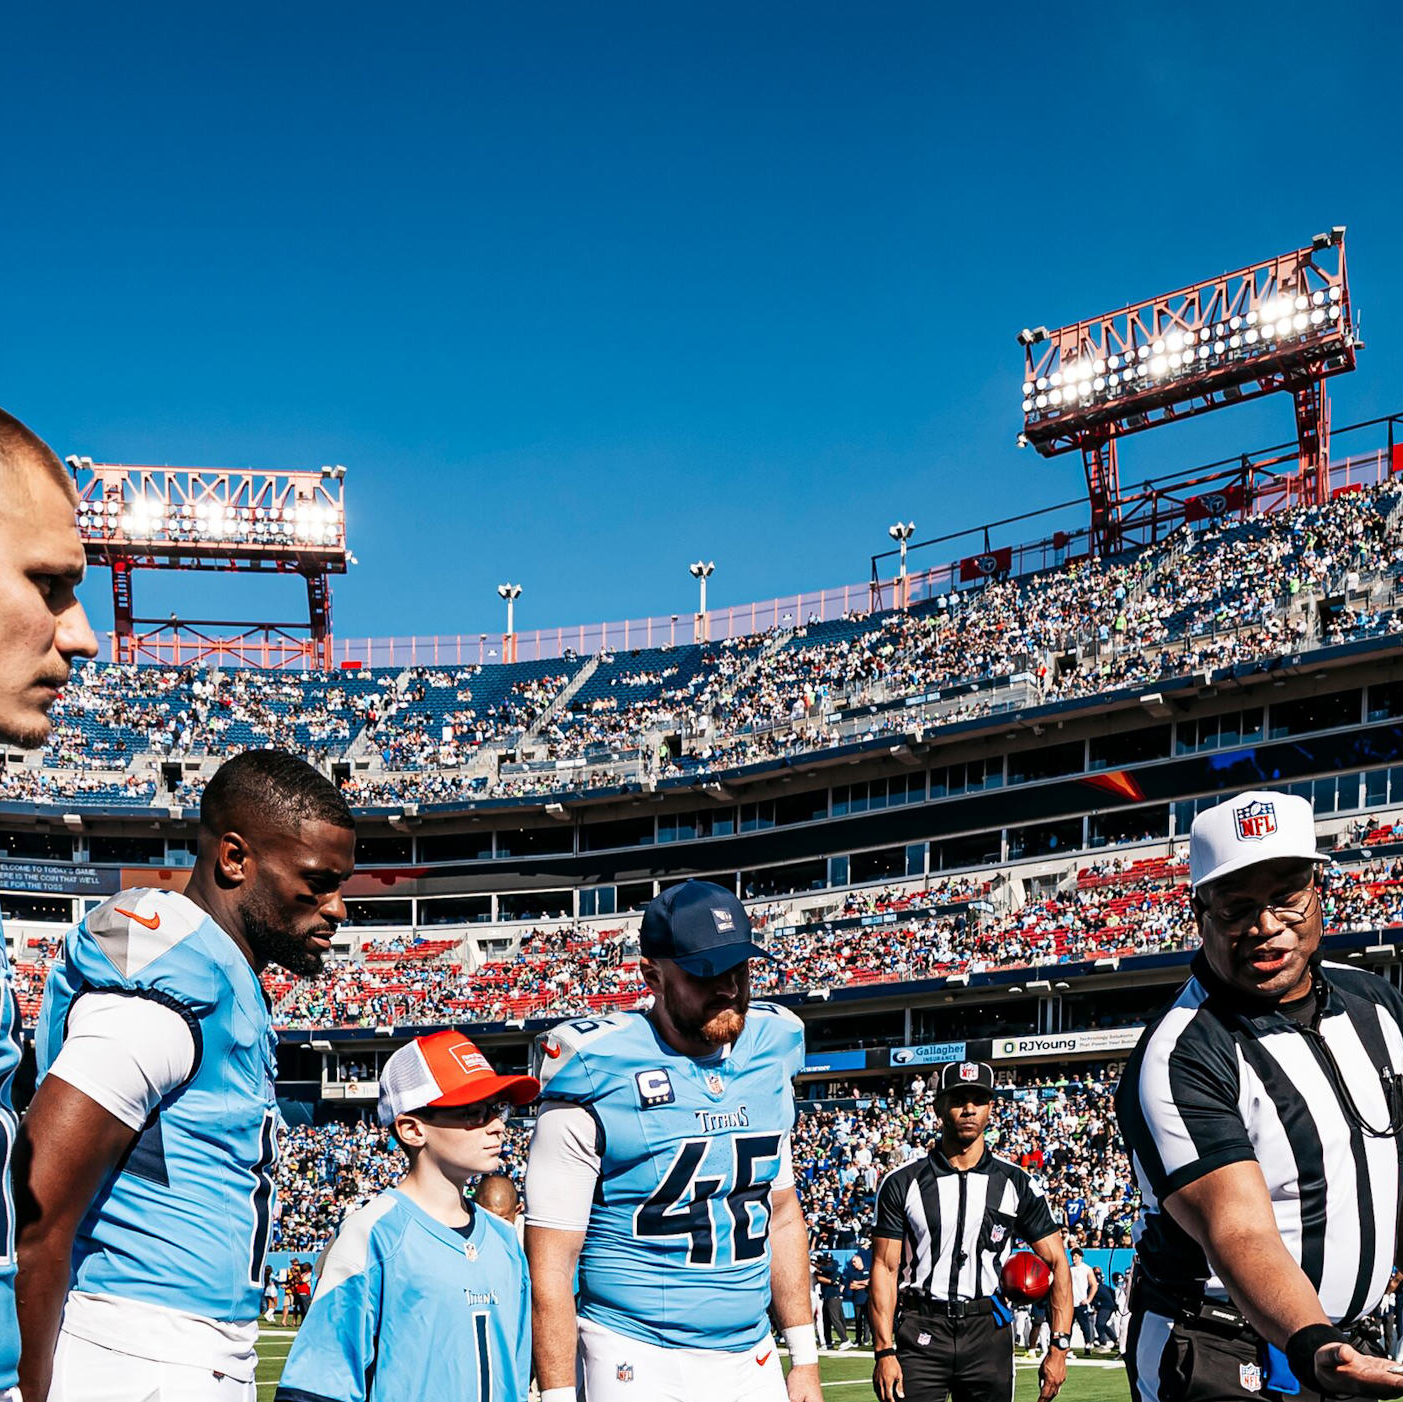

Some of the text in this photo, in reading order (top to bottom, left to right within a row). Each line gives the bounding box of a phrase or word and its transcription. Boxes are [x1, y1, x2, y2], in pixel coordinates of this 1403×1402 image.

[1240, 815, 1274, 836] NFL
[24, 873, 39, 881] THE
[27, 882, 42, 890] THE
[916, 1044, 965, 1058] Gallagher
[922, 1055, 956, 1063] INSURANCE
[632, 1129, 786, 1268] 46
[1068, 1203, 1080, 1215] 27
[1243, 1375, 1262, 1388] NFL
